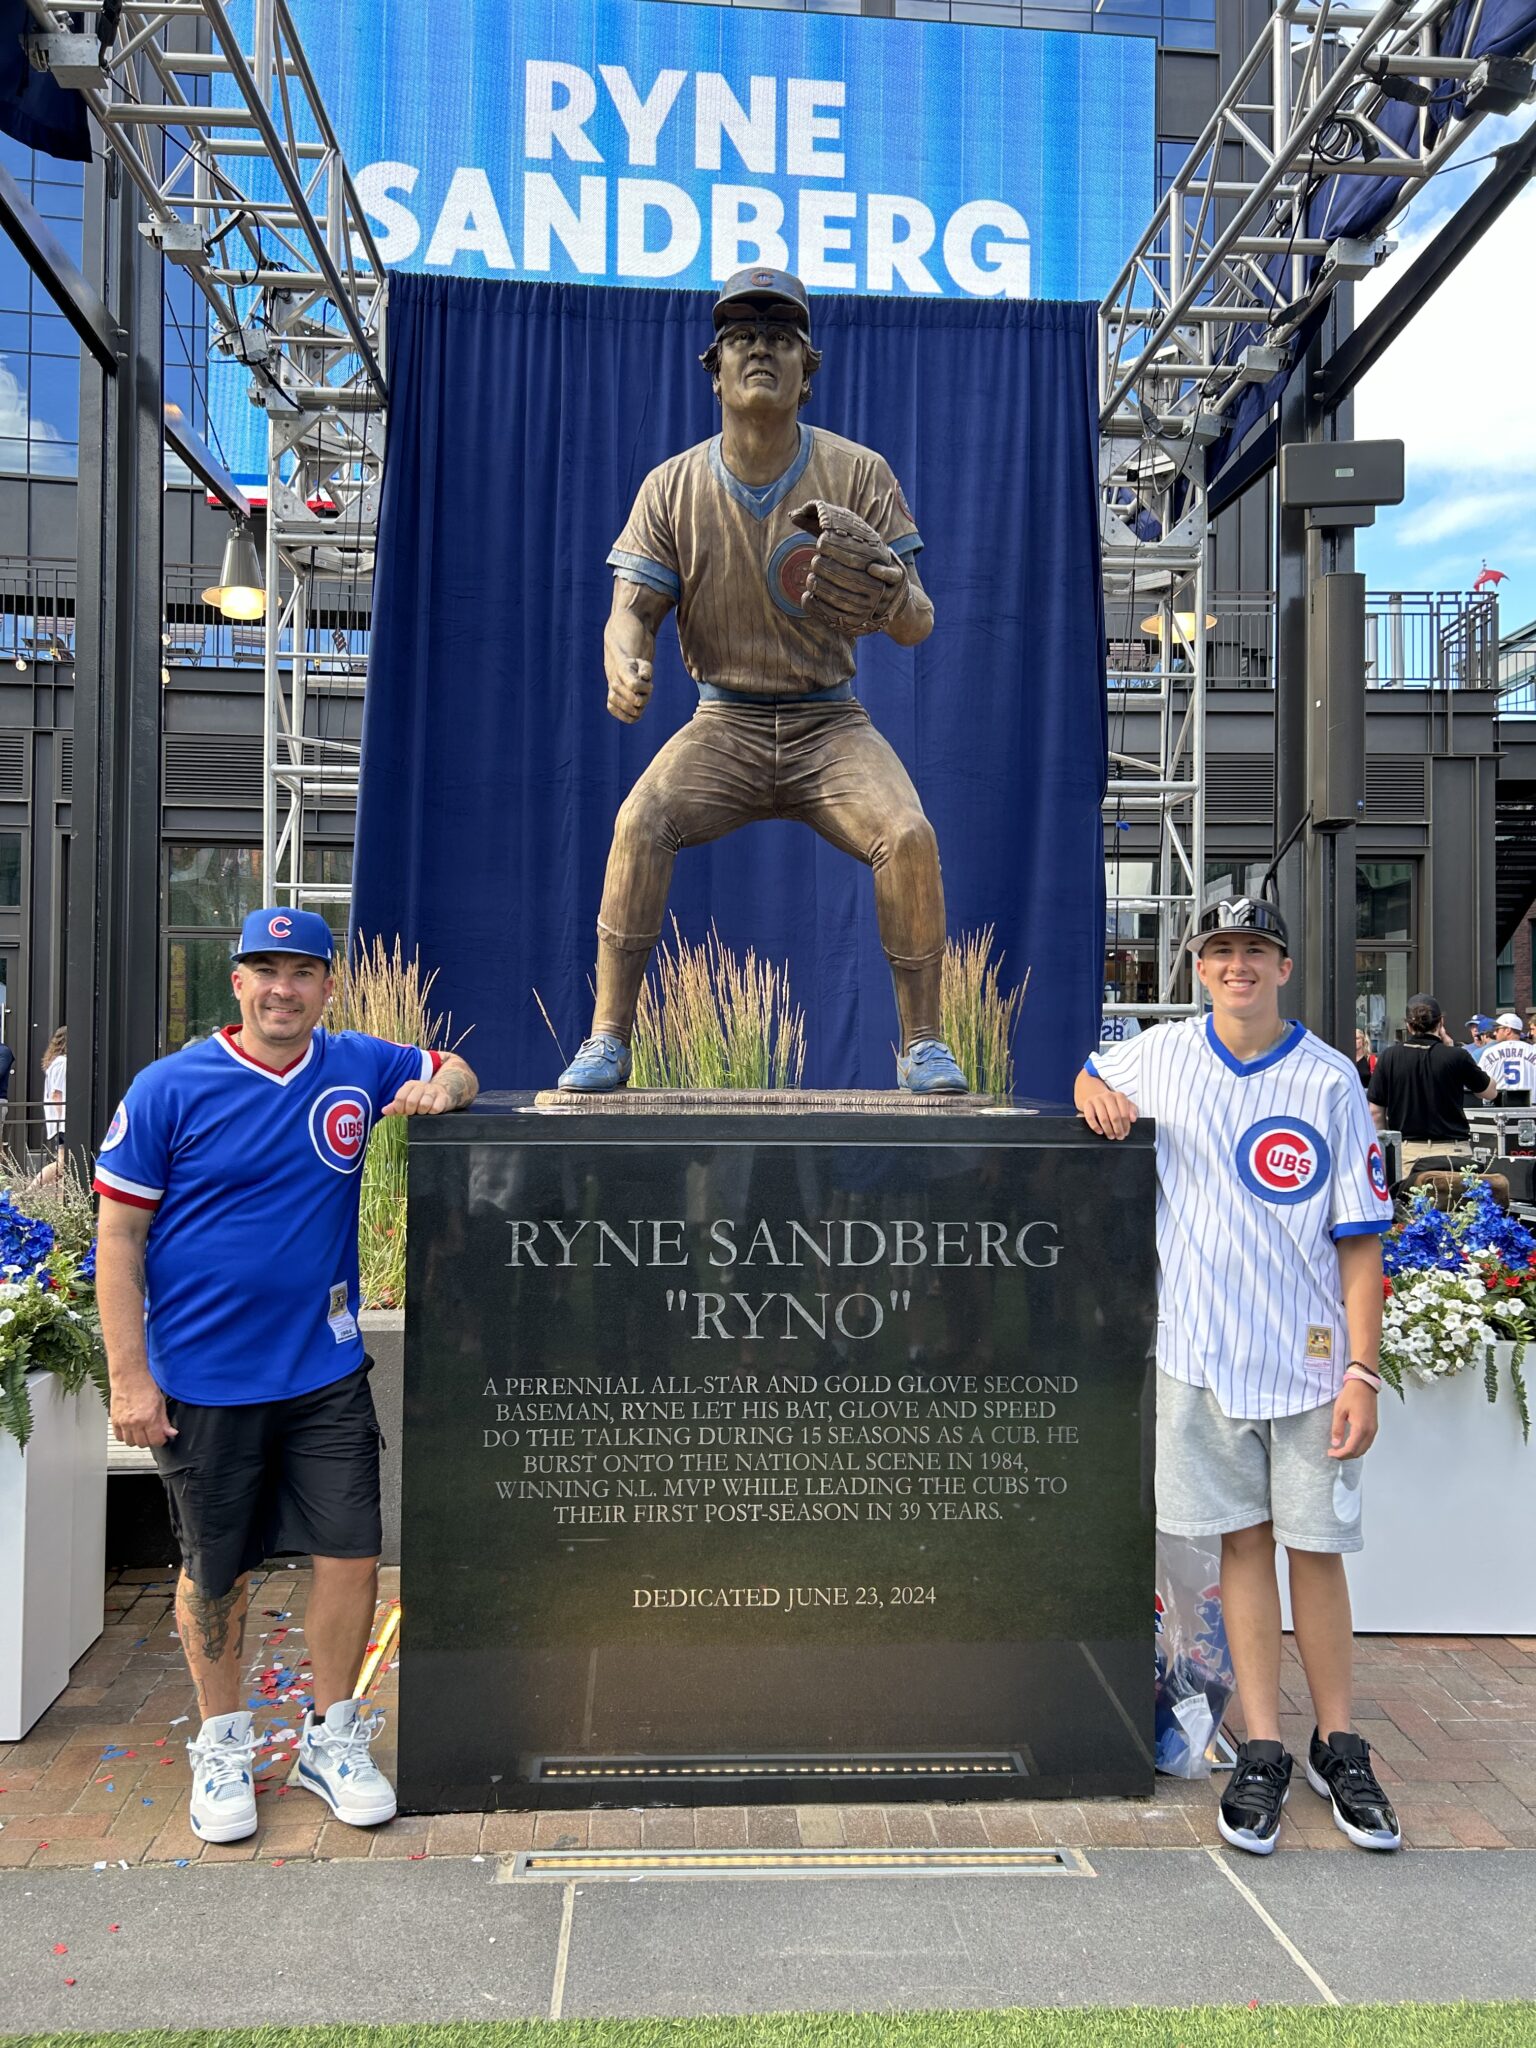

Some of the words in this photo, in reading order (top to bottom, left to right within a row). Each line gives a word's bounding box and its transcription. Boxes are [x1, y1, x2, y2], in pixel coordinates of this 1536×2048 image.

[523, 58, 846, 179] RYNE
[351, 160, 1032, 300] SANDBERG
[268, 916, 292, 938] C
[1101, 1025, 1124, 1041] 28
[1485, 1048, 1524, 1065] ALMORA
[1503, 1061, 1521, 1086] 5
[1254, 1132, 1312, 1188] CUBS
[504, 1219, 690, 1268] RYNE
[708, 1217, 1065, 1270] SANDBERG
[665, 1288, 911, 1341] "RYNO"
[481, 1376, 500, 1396] A
[504, 1376, 645, 1396] PERENNIAL
[649, 1375, 761, 1395] ALL-STAR
[764, 1375, 818, 1394] AND
[823, 1375, 892, 1394] GOLD
[897, 1374, 978, 1394] GLOVE
[983, 1375, 1079, 1394] SECOND
[495, 1401, 615, 1425] BASEMAN,
[620, 1401, 686, 1420] RYNE
[691, 1400, 737, 1420] LET
[741, 1400, 780, 1420] HIS
[785, 1400, 833, 1423] BAT,
[838, 1400, 920, 1419] GLOVE
[925, 1399, 978, 1419] AND
[983, 1400, 1056, 1419] SPEED
[482, 1429, 520, 1448] DO
[525, 1428, 576, 1447] THE
[580, 1426, 692, 1447] TALKING
[697, 1426, 794, 1446] DURING
[800, 1426, 822, 1445] 15
[827, 1425, 931, 1445] SEASONS
[935, 1425, 963, 1444] AS
[968, 1425, 985, 1444] A
[991, 1425, 1040, 1444] CUB.
[1046, 1425, 1079, 1444] HE
[522, 1452, 598, 1474] BURST
[602, 1453, 674, 1473] ONTO
[679, 1453, 729, 1472] THE
[734, 1452, 861, 1472] NATIONAL
[865, 1452, 942, 1471] SCENE
[946, 1452, 974, 1471] IN
[980, 1451, 1029, 1474] 1984,
[494, 1479, 611, 1500] WINNING
[616, 1479, 657, 1498] N.L.
[663, 1478, 716, 1497] MVP
[721, 1477, 799, 1497] WHILE
[804, 1476, 913, 1496] LEADING
[917, 1476, 967, 1495] THE
[972, 1476, 1030, 1495] CUBS
[1034, 1476, 1068, 1495] TO
[552, 1504, 628, 1525] THEIR
[632, 1503, 699, 1523] FIRST
[703, 1502, 860, 1524] POST-SEASON
[865, 1502, 893, 1521] IN
[899, 1502, 921, 1521] 39
[925, 1501, 1004, 1521] YEARS.
[631, 1585, 781, 1608] DEDICATED
[784, 1587, 849, 1613] JUNE
[854, 1586, 884, 1609] 23,
[889, 1586, 937, 1605] 2024
